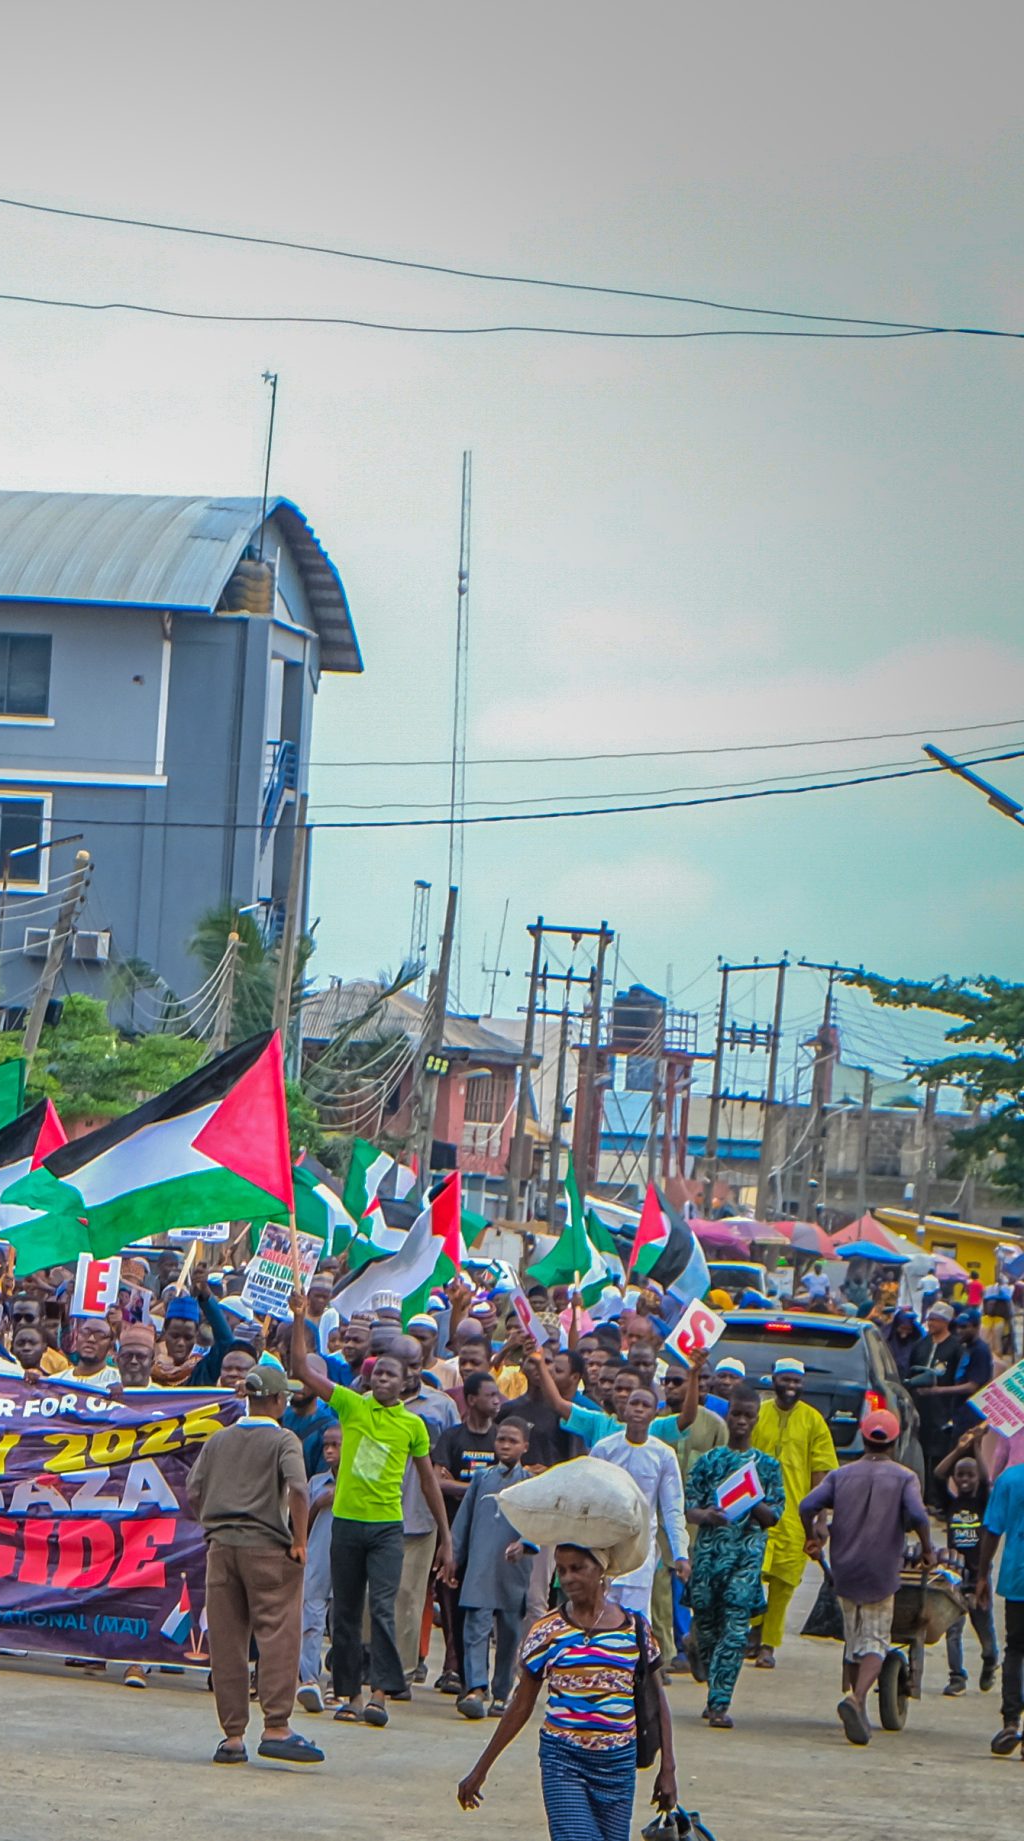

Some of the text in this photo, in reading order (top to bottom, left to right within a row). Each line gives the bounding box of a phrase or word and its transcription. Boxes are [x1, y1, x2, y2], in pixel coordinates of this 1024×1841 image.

[82, 1260, 110, 1312] E
[677, 1310, 716, 1355] S
[22, 1393, 78, 1418] FOR
[43, 1403, 226, 1473] 2025
[720, 1470, 758, 1510] T
[93, 1614, 149, 1640] (MAI)
